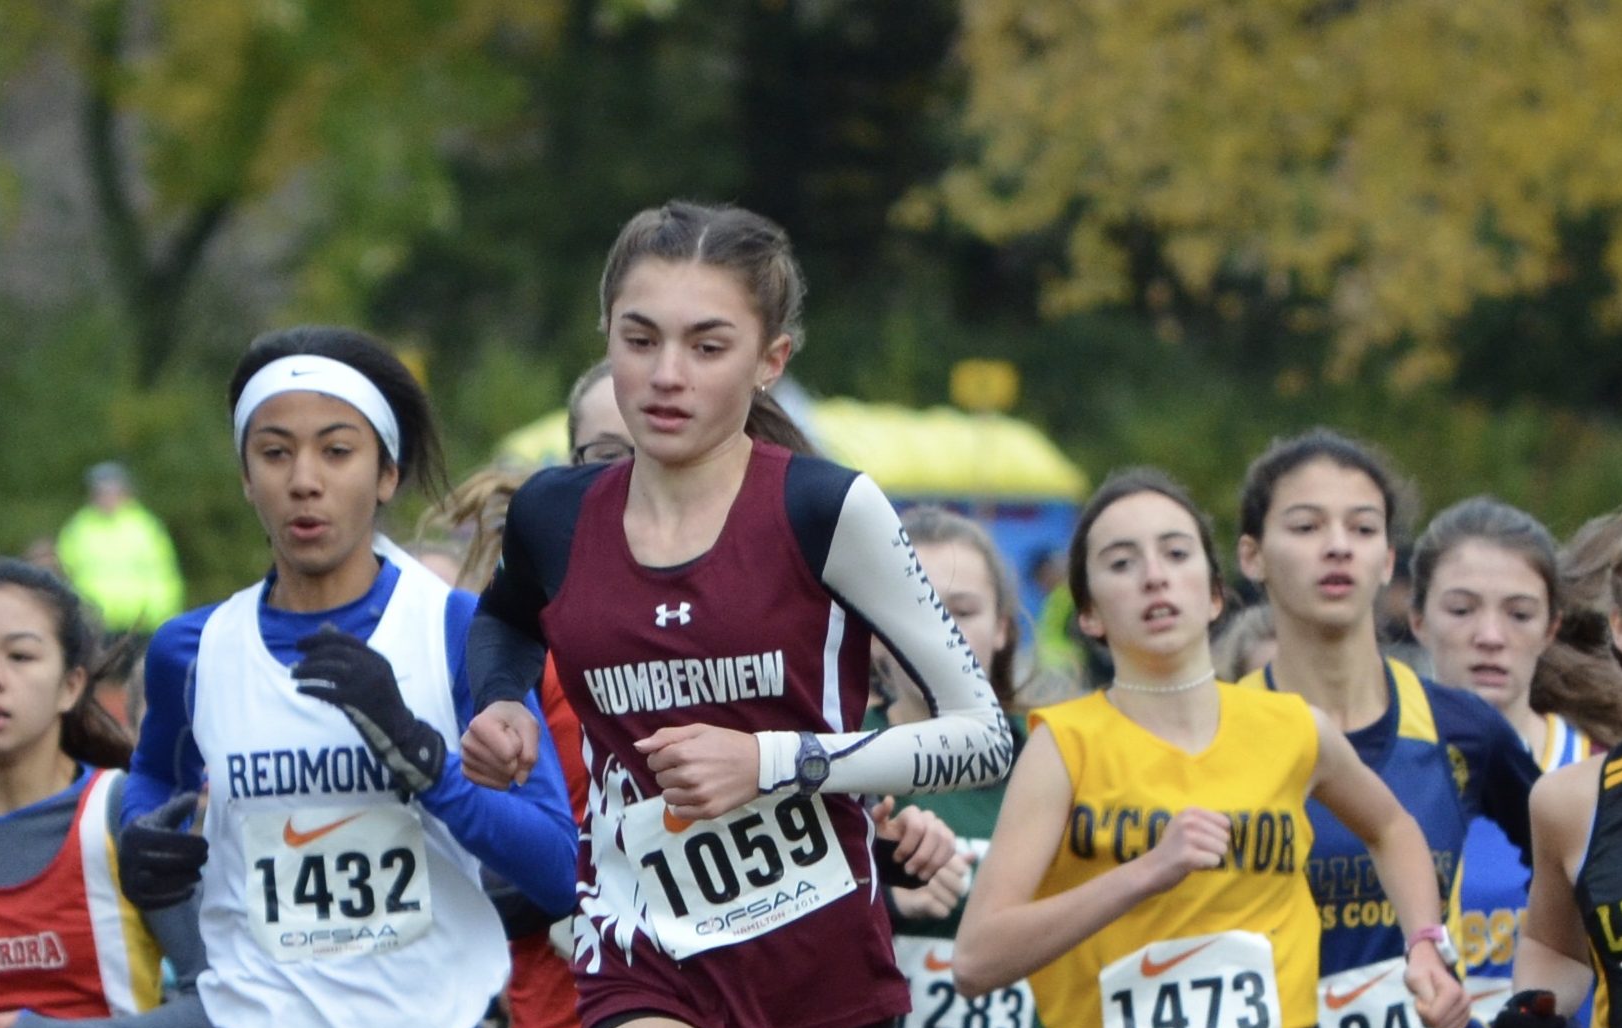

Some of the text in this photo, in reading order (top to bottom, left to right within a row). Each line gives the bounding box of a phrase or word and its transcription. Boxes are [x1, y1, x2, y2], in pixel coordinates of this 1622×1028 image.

[584, 650, 784, 716] HUMBERVIEW
[227, 746, 396, 799] REDMON
[640, 796, 829, 918] 1059
[1071, 804, 1295, 874] O'CONOR
[254, 847, 421, 924] 1432
[695, 880, 816, 936] OFSAA
[280, 924, 398, 948] OFSAA
